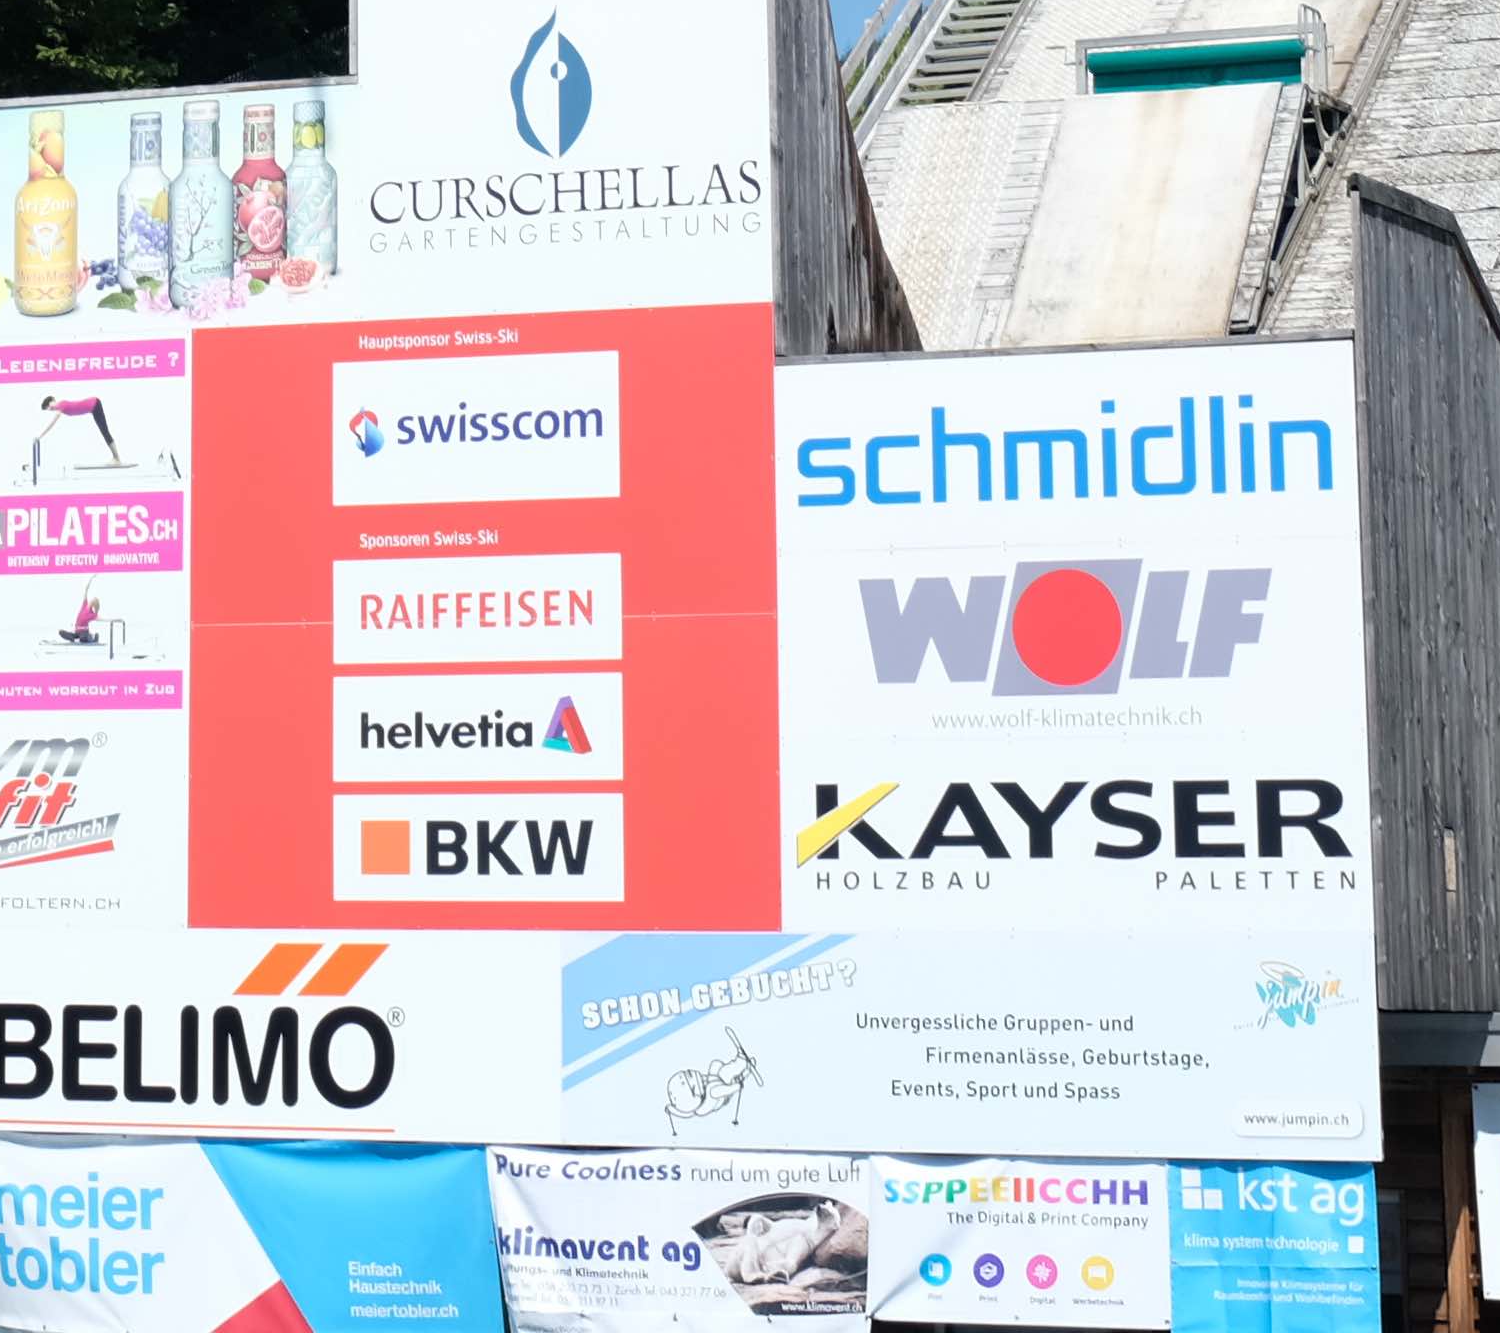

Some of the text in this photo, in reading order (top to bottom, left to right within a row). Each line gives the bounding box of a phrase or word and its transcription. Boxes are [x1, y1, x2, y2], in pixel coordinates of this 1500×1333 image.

[369, 160, 762, 224] CURSCHELLAS
[369, 211, 762, 254] GARTENGESTALTUNG
[358, 328, 519, 351] Hauptsponsor Swiss-Ski
[396, 401, 604, 445] swisscom
[797, 394, 1334, 507] schmidlin
[359, 528, 499, 551] Sponsoren Swiss-Ski
[55, 553, 99, 566] EFFECTIV
[360, 589, 593, 630] RAIFFEISEN
[858, 558, 1273, 697] WOLF
[360, 709, 533, 749] helvetia
[930, 705, 1203, 731] www.wolf-klimatechnik.ch
[800, 779, 1354, 861] KAYSER
[426, 820, 594, 876] BKW
[816, 870, 1357, 892] HOLZBAU PALETTEN
[581, 988, 683, 1030] SCHON
[691, 962, 834, 1012] GEBUCHT
[855, 1013, 1134, 1035] Unvergessliche Gruppen- und
[925, 1046, 1211, 1070] Firmenanlässe, Geburtstage,
[890, 1080, 1121, 1102] Events, Sport und Spass
[1243, 1112, 1350, 1128] www.jumpin.ch
[494, 1153, 862, 1190] Pure Coolness rund um gute Luft
[884, 1176, 1150, 1206] SSPPEEIICCHH
[1237, 1166, 1364, 1226] kst ag
[946, 1210, 1150, 1231] The Digital & Print Company
[497, 1225, 702, 1272] klimavent ag
[1183, 1233, 1220, 1247] klima
[1223, 1235, 1264, 1251] system
[348, 1260, 402, 1277] Einfach
[575, 1267, 650, 1280] Klimatechnik
[348, 1278, 443, 1295] Haustechnik
[350, 1303, 460, 1318] meiertobler.ch
